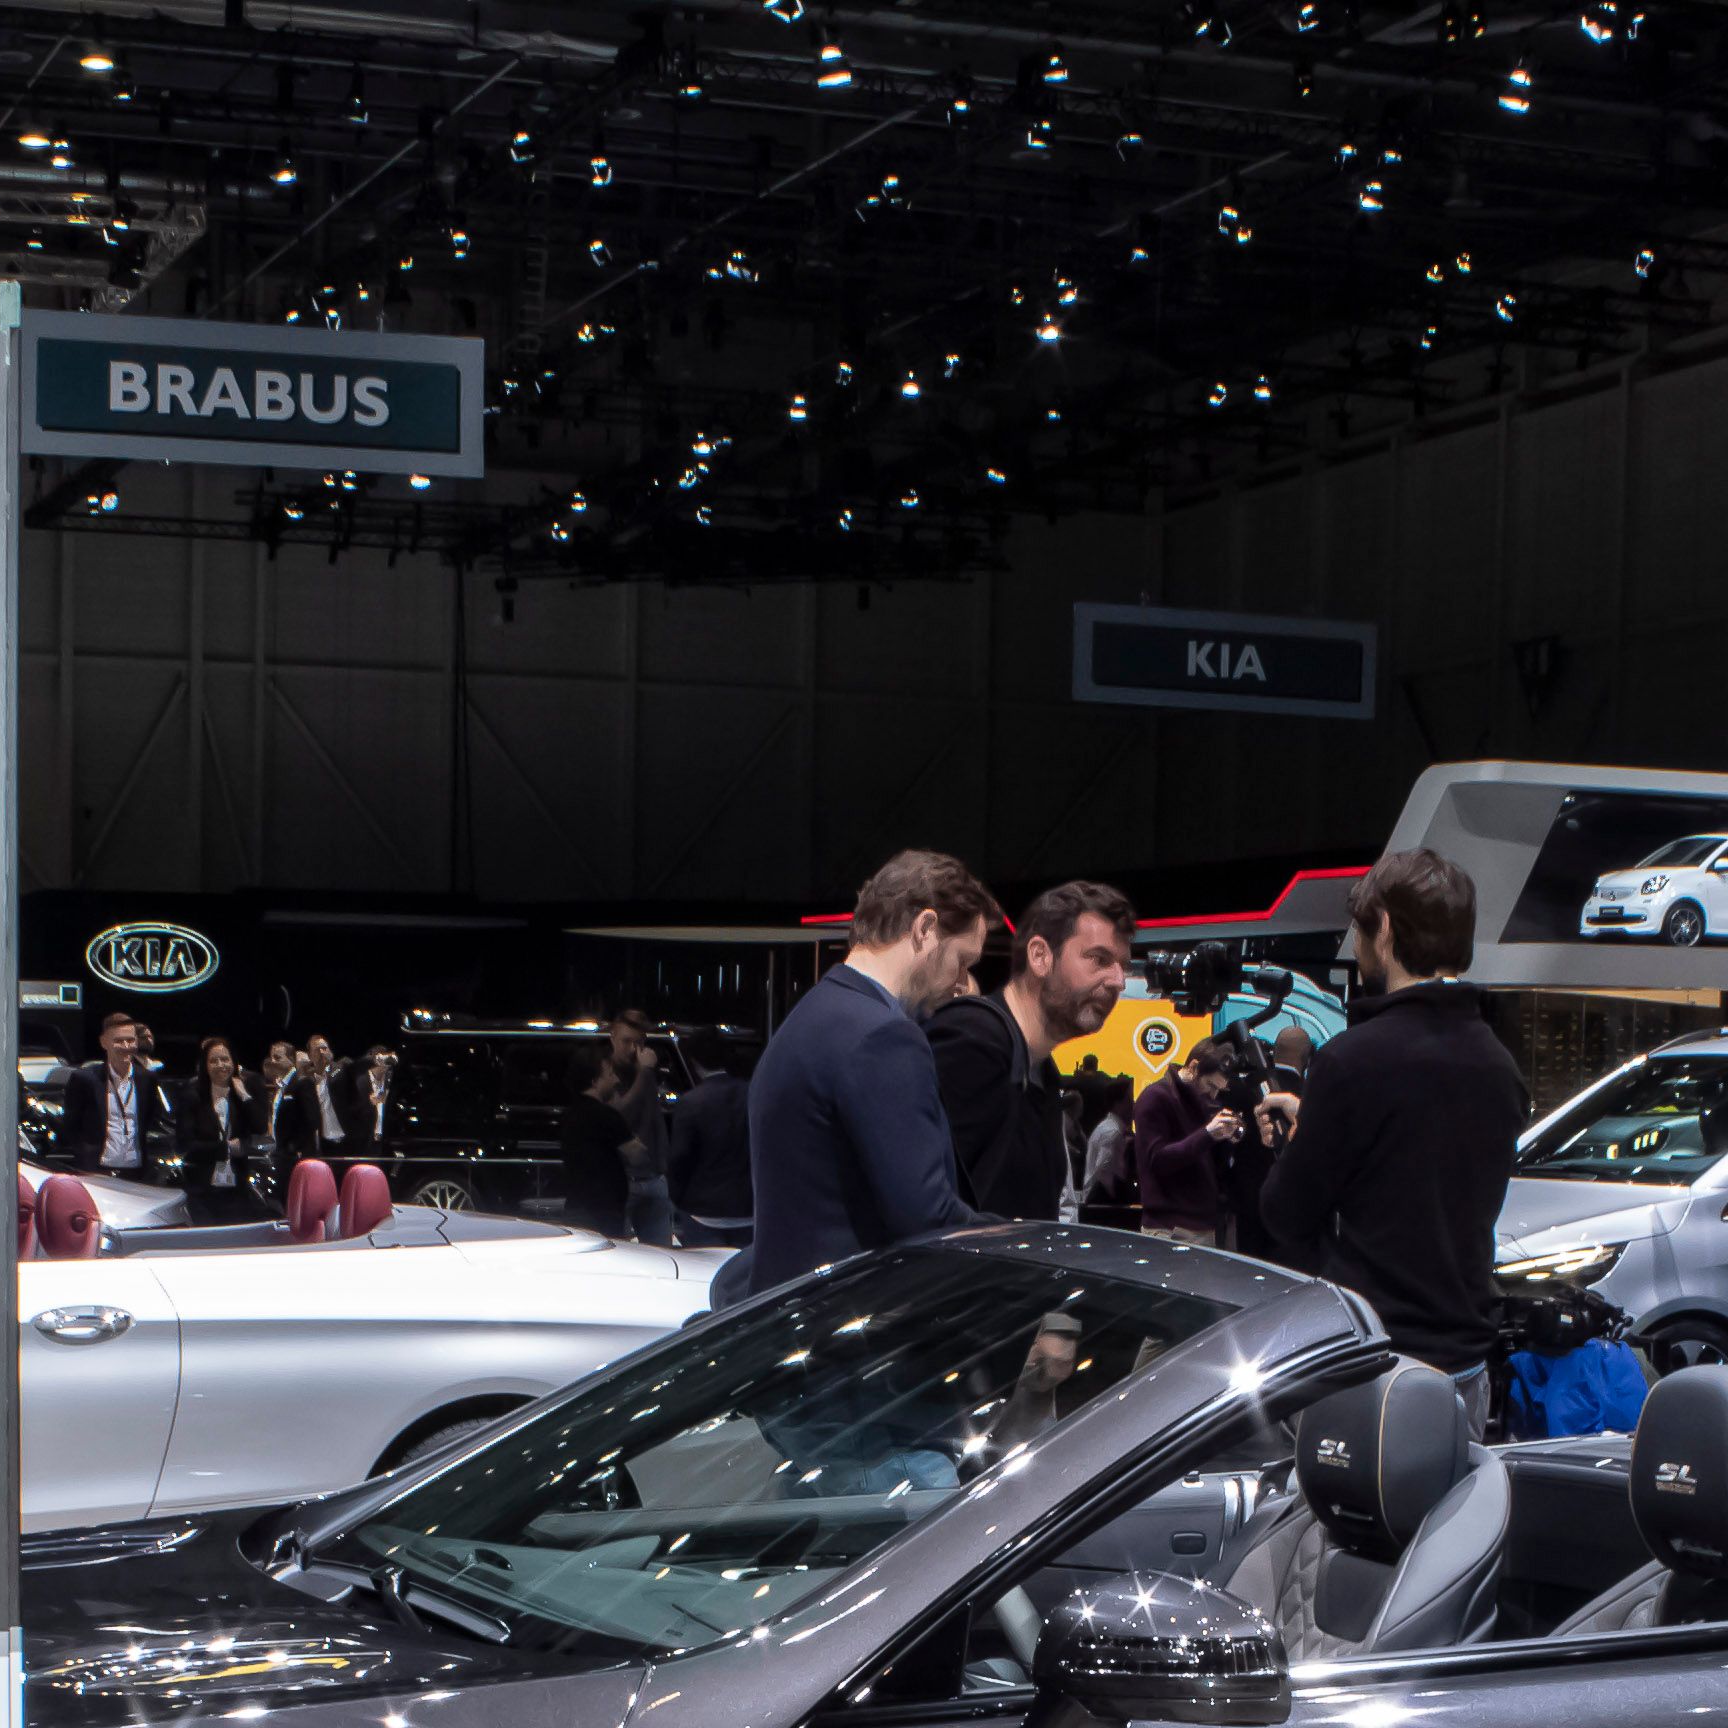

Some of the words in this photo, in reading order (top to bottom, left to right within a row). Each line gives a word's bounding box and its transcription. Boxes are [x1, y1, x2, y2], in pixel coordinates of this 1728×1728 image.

[109, 361, 391, 427] BRABUS
[1186, 640, 1267, 682] KIA
[109, 936, 196, 977] KIA
[1317, 1439, 1351, 1459] SL
[1655, 1462, 1698, 1484] SL
